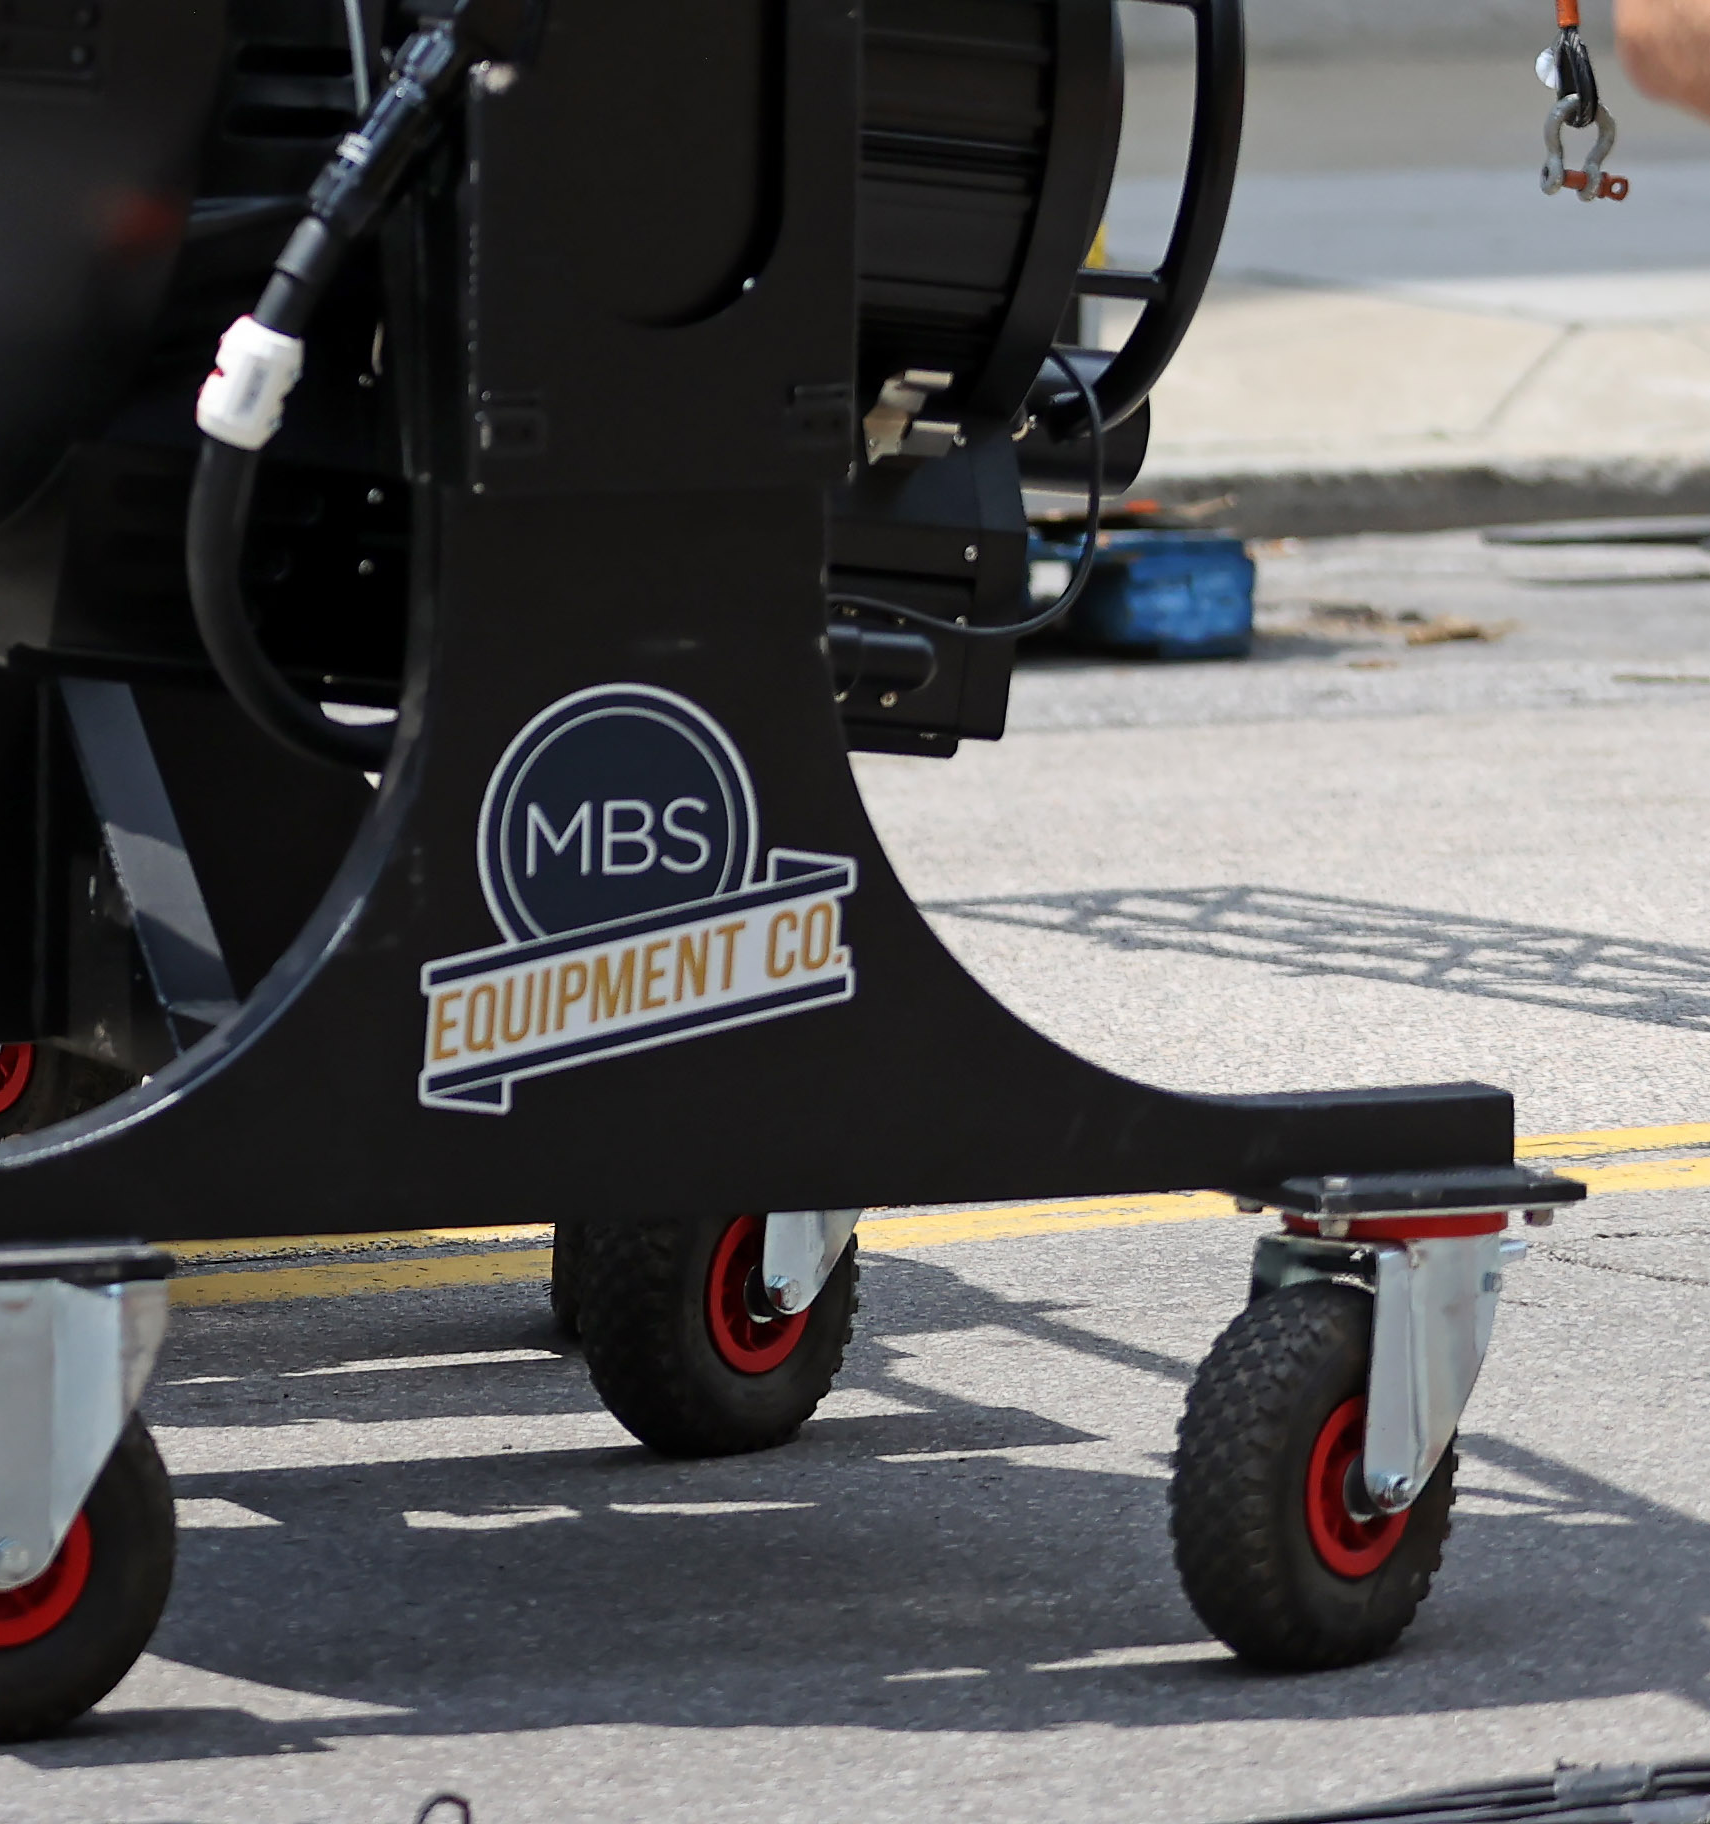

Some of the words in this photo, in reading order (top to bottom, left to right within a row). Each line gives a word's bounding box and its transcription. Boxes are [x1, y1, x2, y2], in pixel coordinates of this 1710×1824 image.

[525, 796, 712, 878] MBS
[430, 920, 747, 1062] EQUIPMENT
[765, 901, 845, 979] CO.
